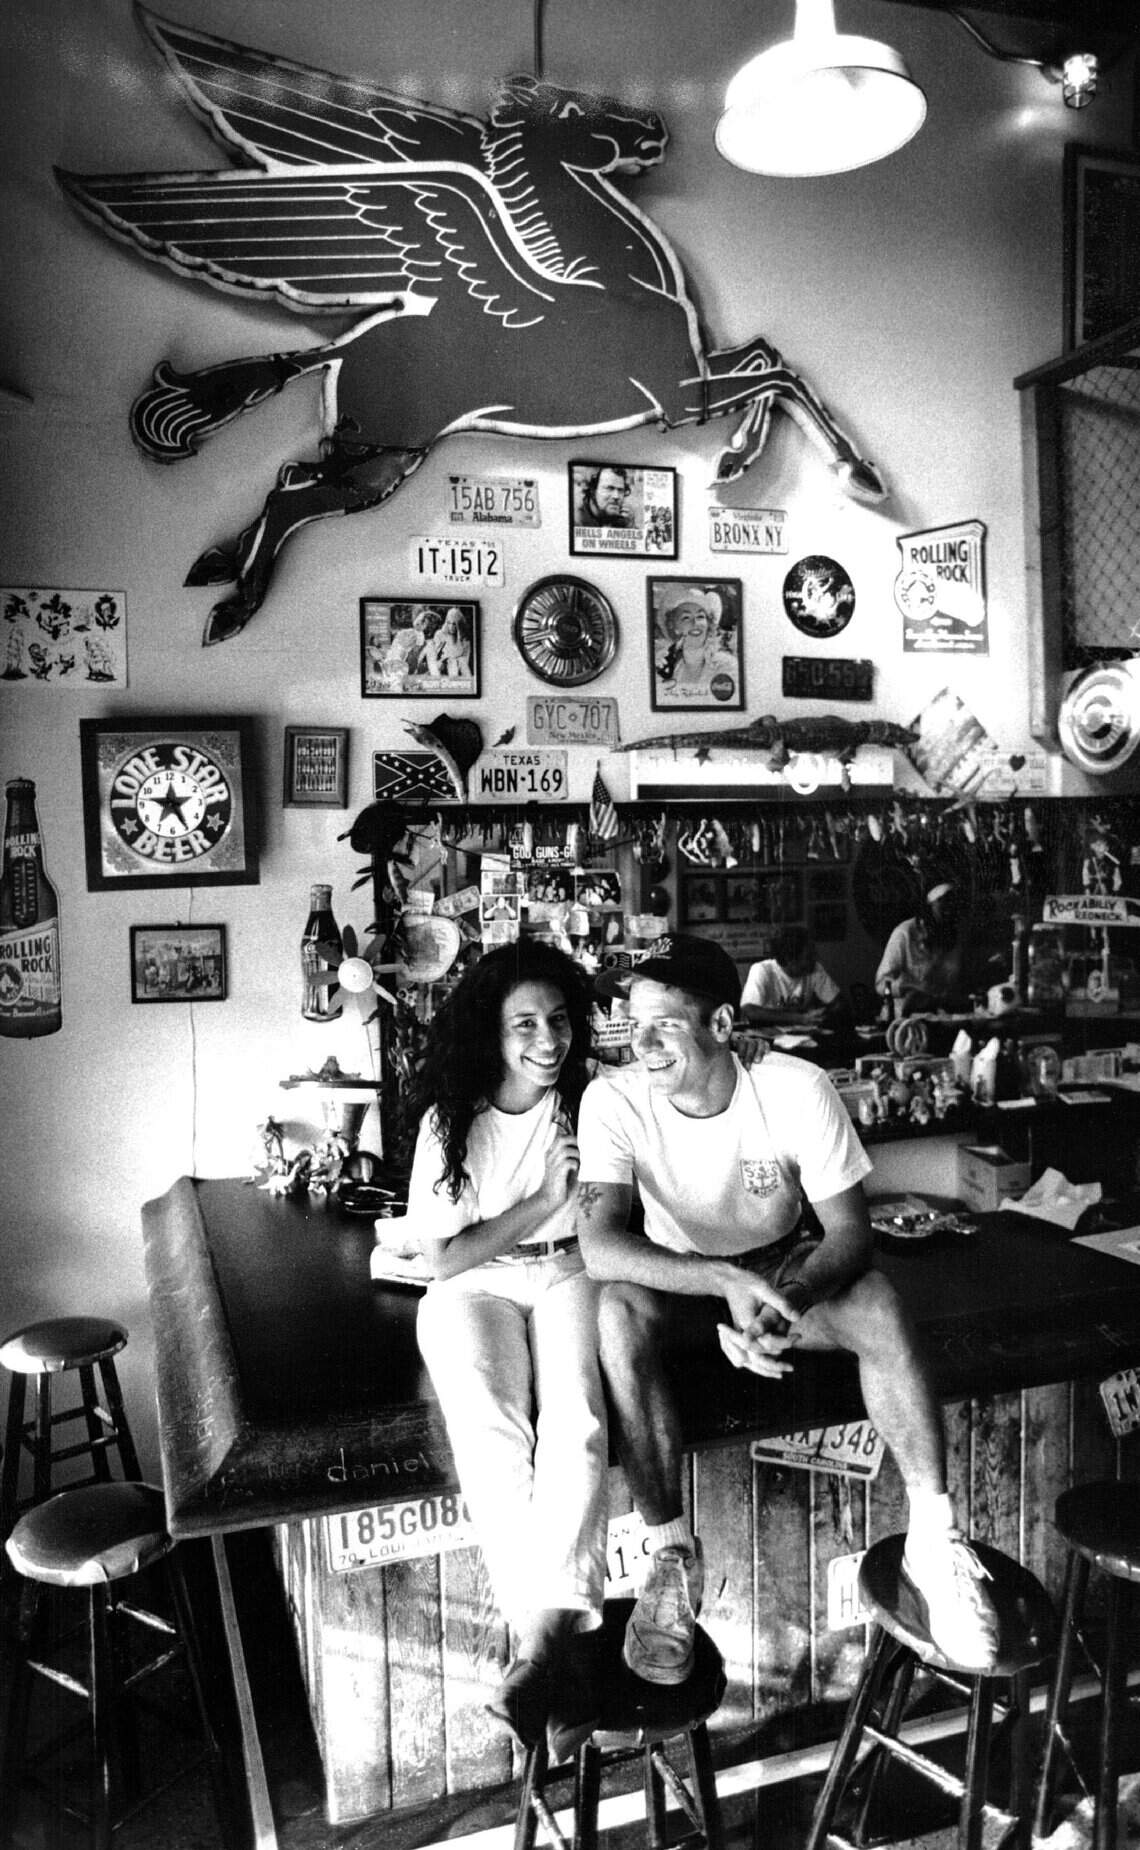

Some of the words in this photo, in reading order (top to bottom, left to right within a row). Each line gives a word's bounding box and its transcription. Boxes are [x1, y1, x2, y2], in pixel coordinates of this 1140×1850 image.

[451, 485, 495, 511] 15AB
[501, 487, 535, 512] 756
[472, 511, 513, 523] Alabama
[575, 528, 603, 539] HELLS
[605, 529, 644, 540] ANGELS
[713, 522, 761, 546] BRONX
[765, 525, 783, 547] NY
[437, 539, 476, 547] TEXAS
[582, 539, 597, 549] ON
[600, 540, 637, 550] WHEELS
[910, 540, 969, 564] ROLLING
[936, 564, 970, 584] ROCK
[578, 704, 611, 730] 707
[503, 755, 541, 766] TEXAS
[111, 747, 166, 808] LONE
[171, 745, 229, 804] STAR
[153, 776, 161, 785] 11
[165, 772, 175, 781] 12
[143, 787, 153, 795] 10
[192, 785, 198, 793] 2
[131, 829, 212, 862] BEER
[20, 957, 52, 973] ROCK
[327, 1447, 430, 1483] daniel
